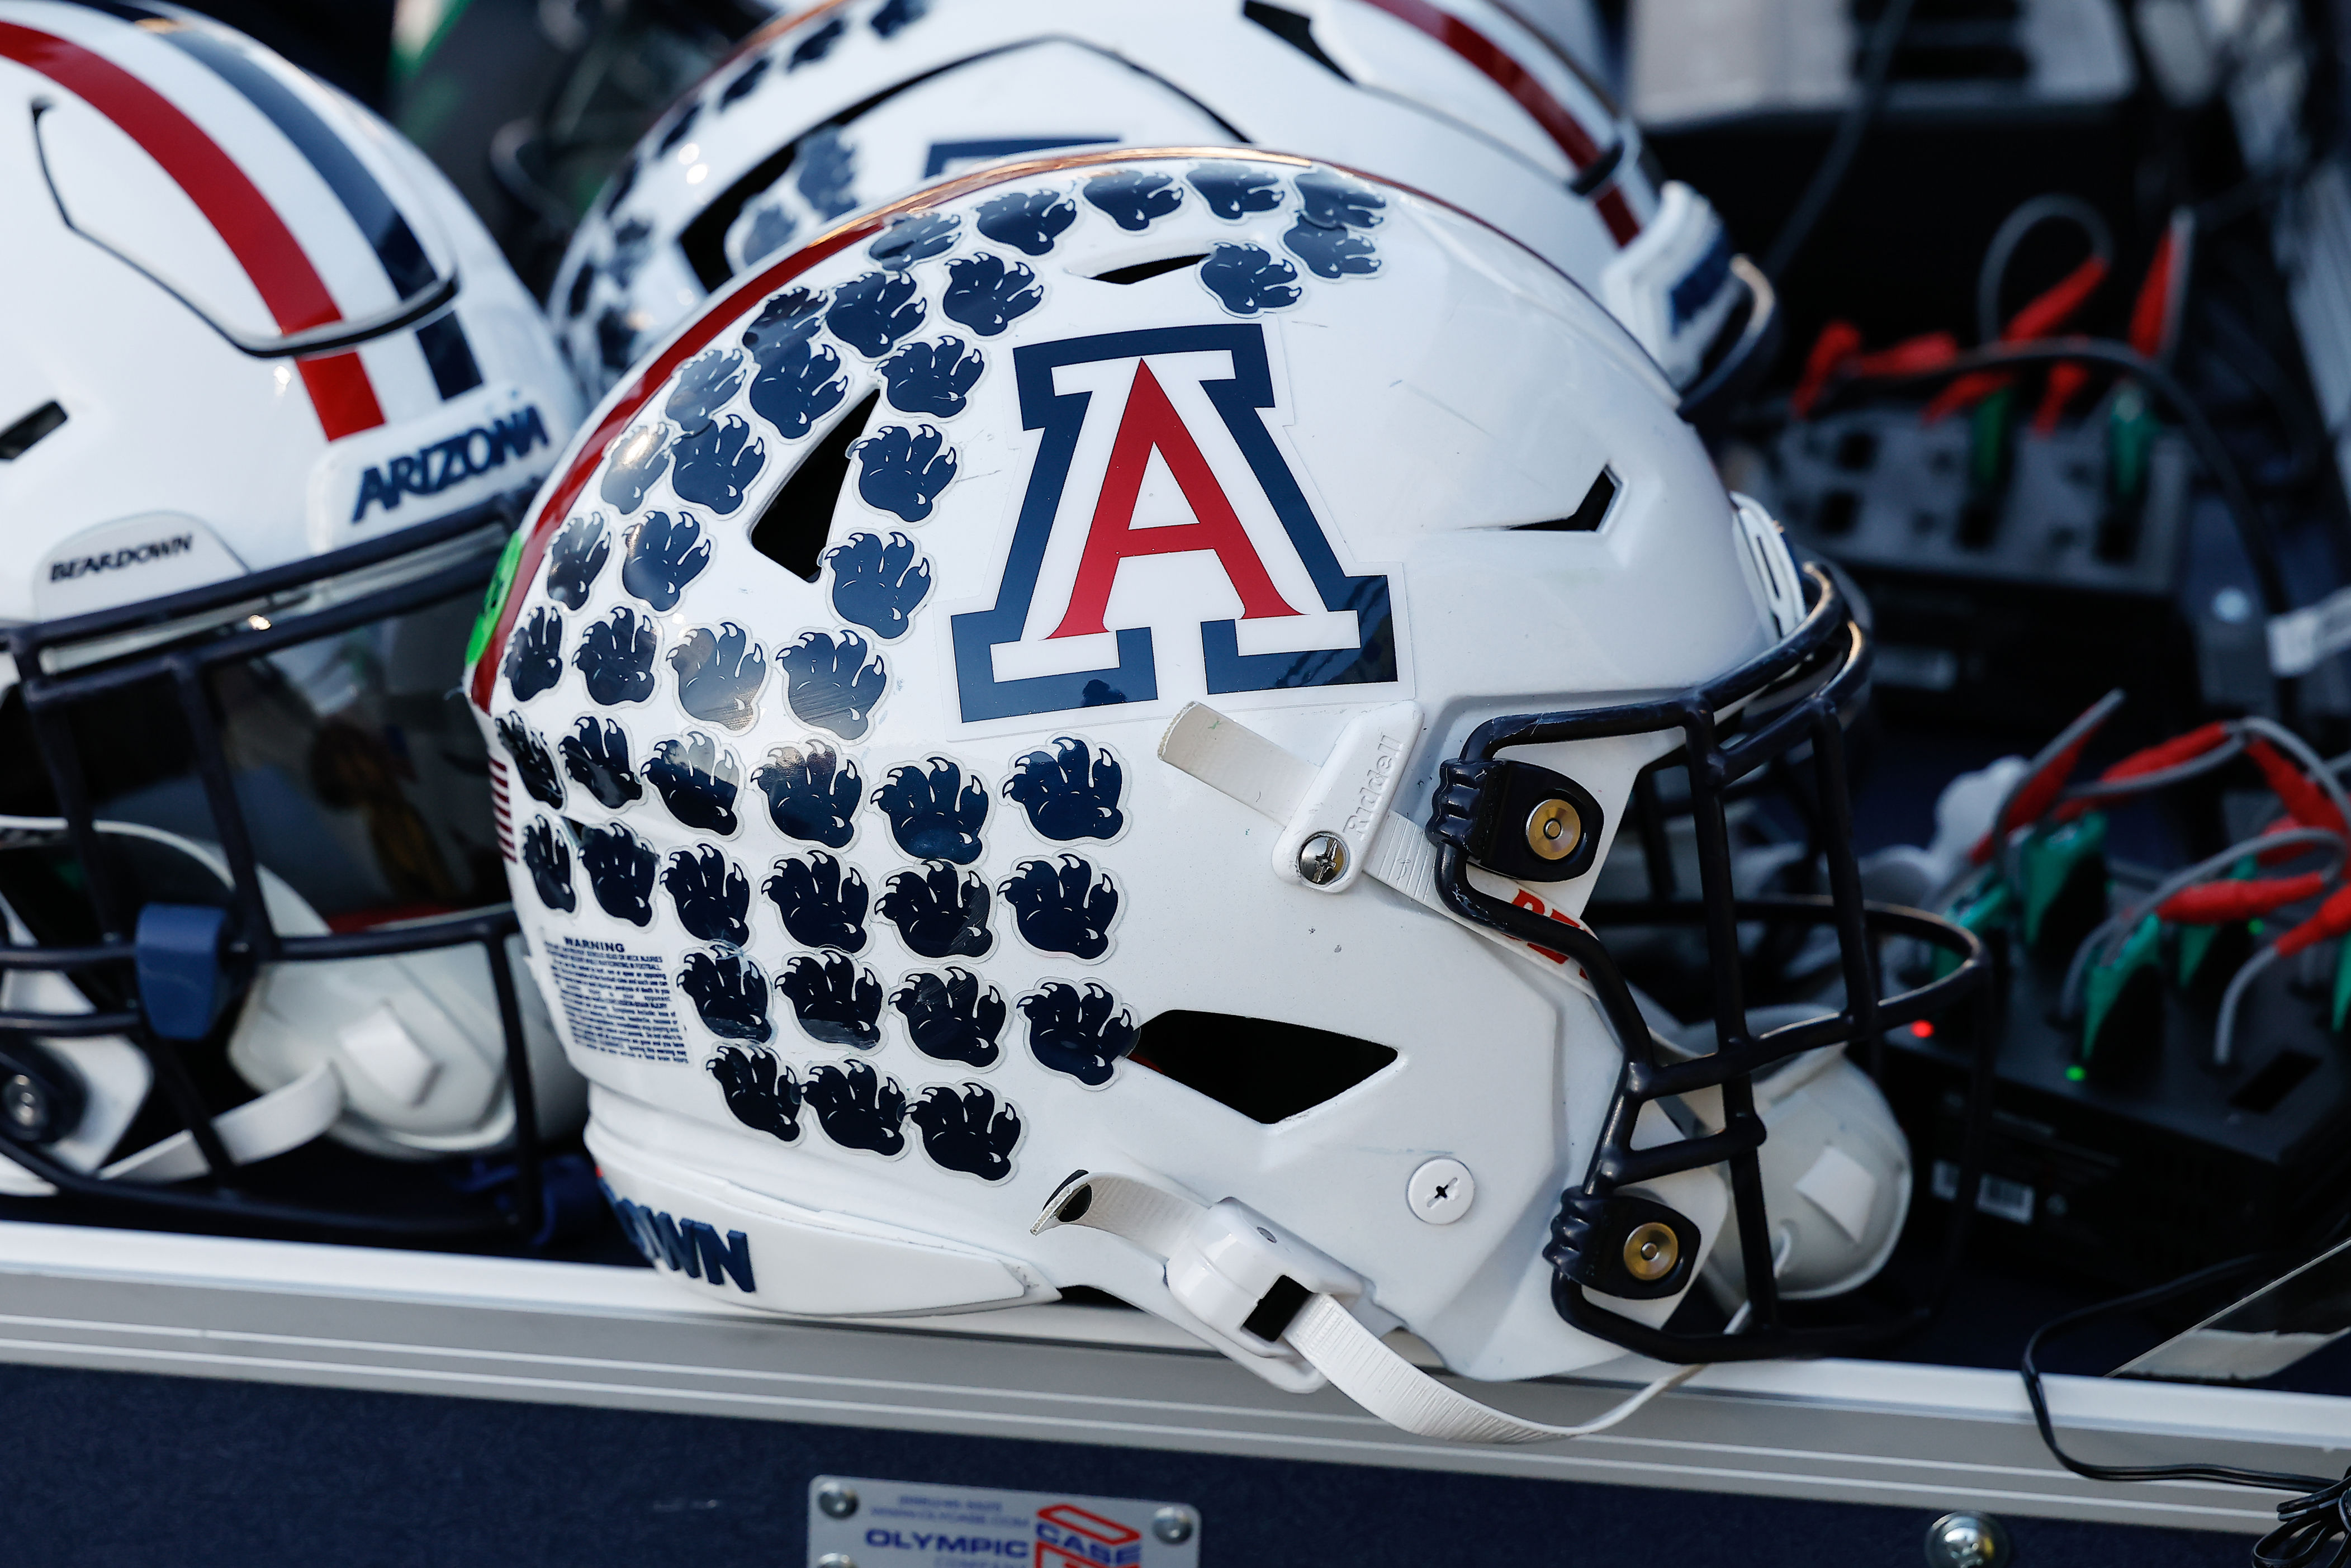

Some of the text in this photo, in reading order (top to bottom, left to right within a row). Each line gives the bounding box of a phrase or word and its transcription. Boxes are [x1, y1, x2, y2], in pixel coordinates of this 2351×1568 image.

[352, 405, 549, 523] ARIZONA
[950, 324, 1398, 723] A
[49, 532, 194, 582] BEARDOWN
[1342, 734, 1404, 841] Riddell
[563, 936, 625, 953] WARNING
[865, 1528, 1030, 1559] OLYMPIC
[1035, 1521, 1142, 1567] CASE
